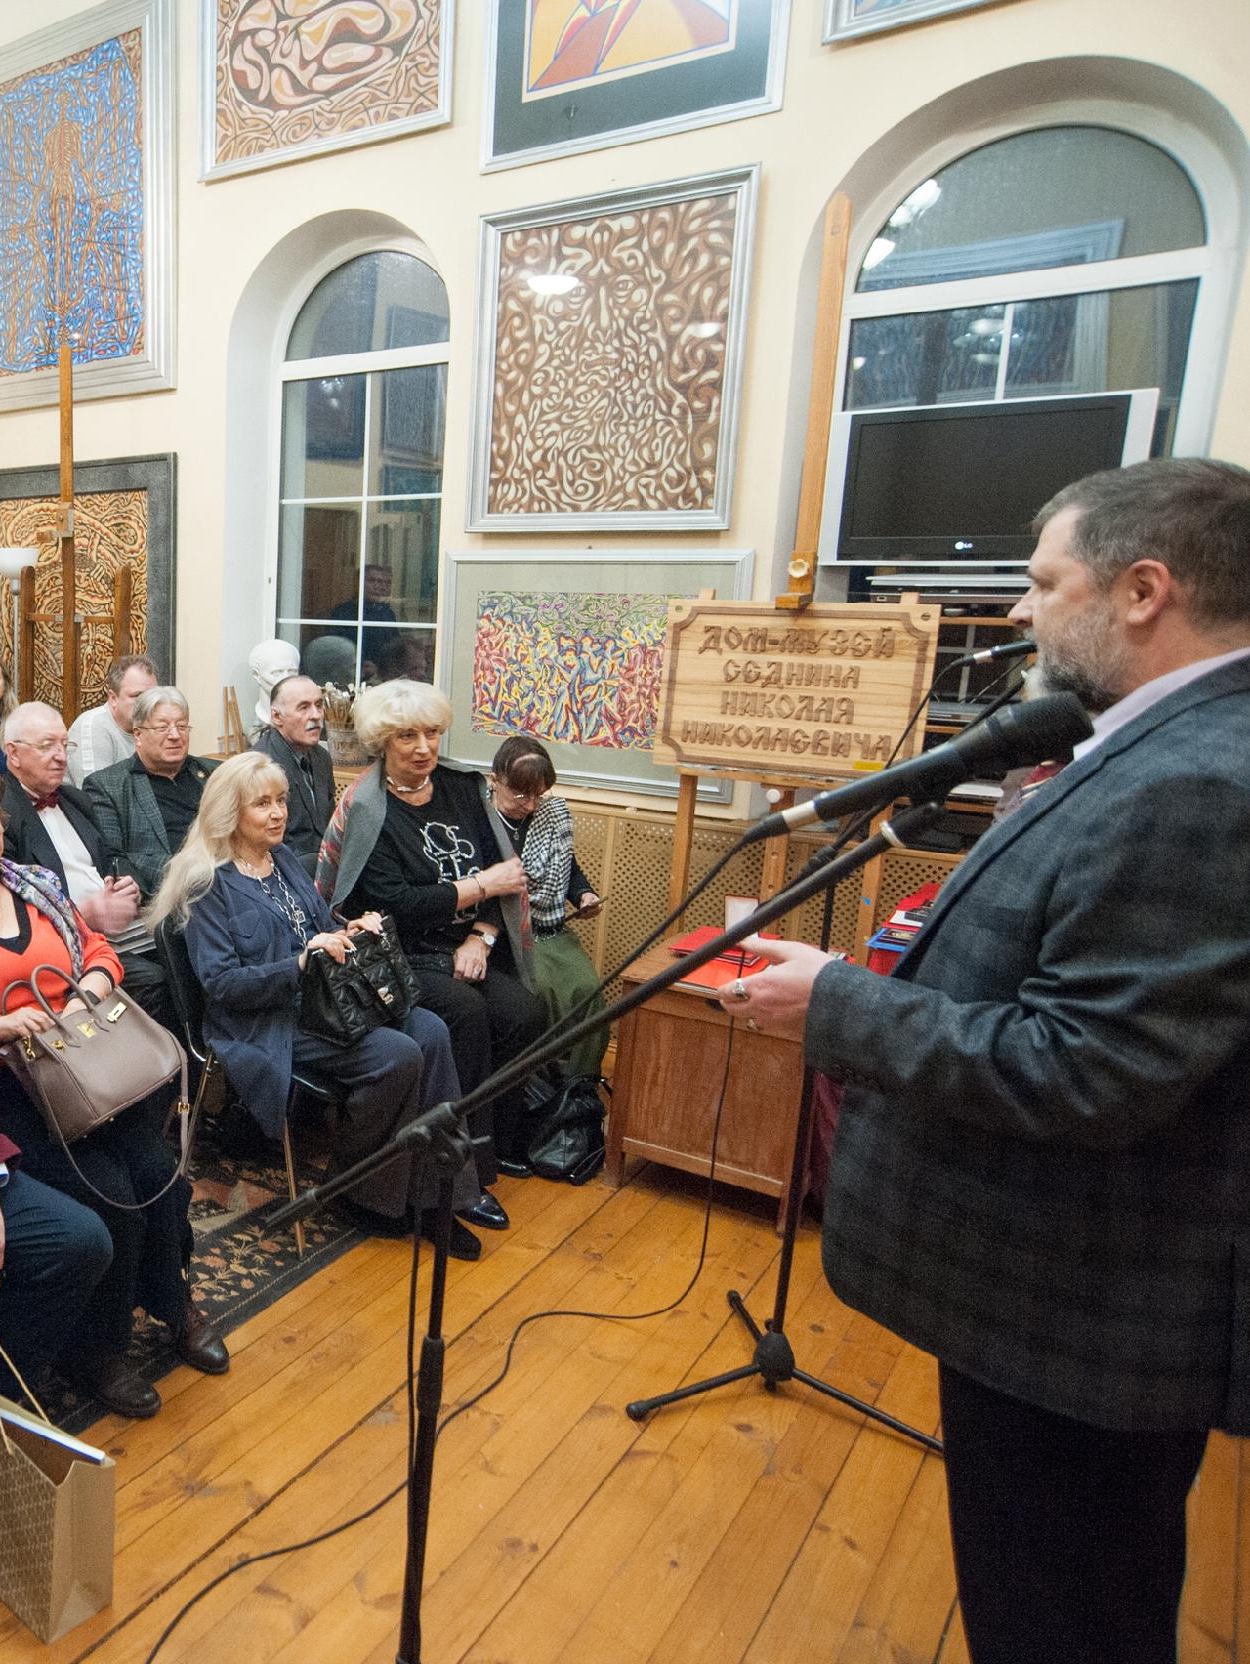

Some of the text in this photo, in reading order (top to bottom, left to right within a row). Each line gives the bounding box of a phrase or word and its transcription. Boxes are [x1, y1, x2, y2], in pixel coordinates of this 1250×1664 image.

[698, 626, 896, 658] ДОМ-МУЗЕЙ
[723, 659, 861, 689] СЕДНИНА
[721, 691, 855, 724] НИКОЛАЯ
[681, 721, 891, 761] НИКОЛАЕВИЧА
